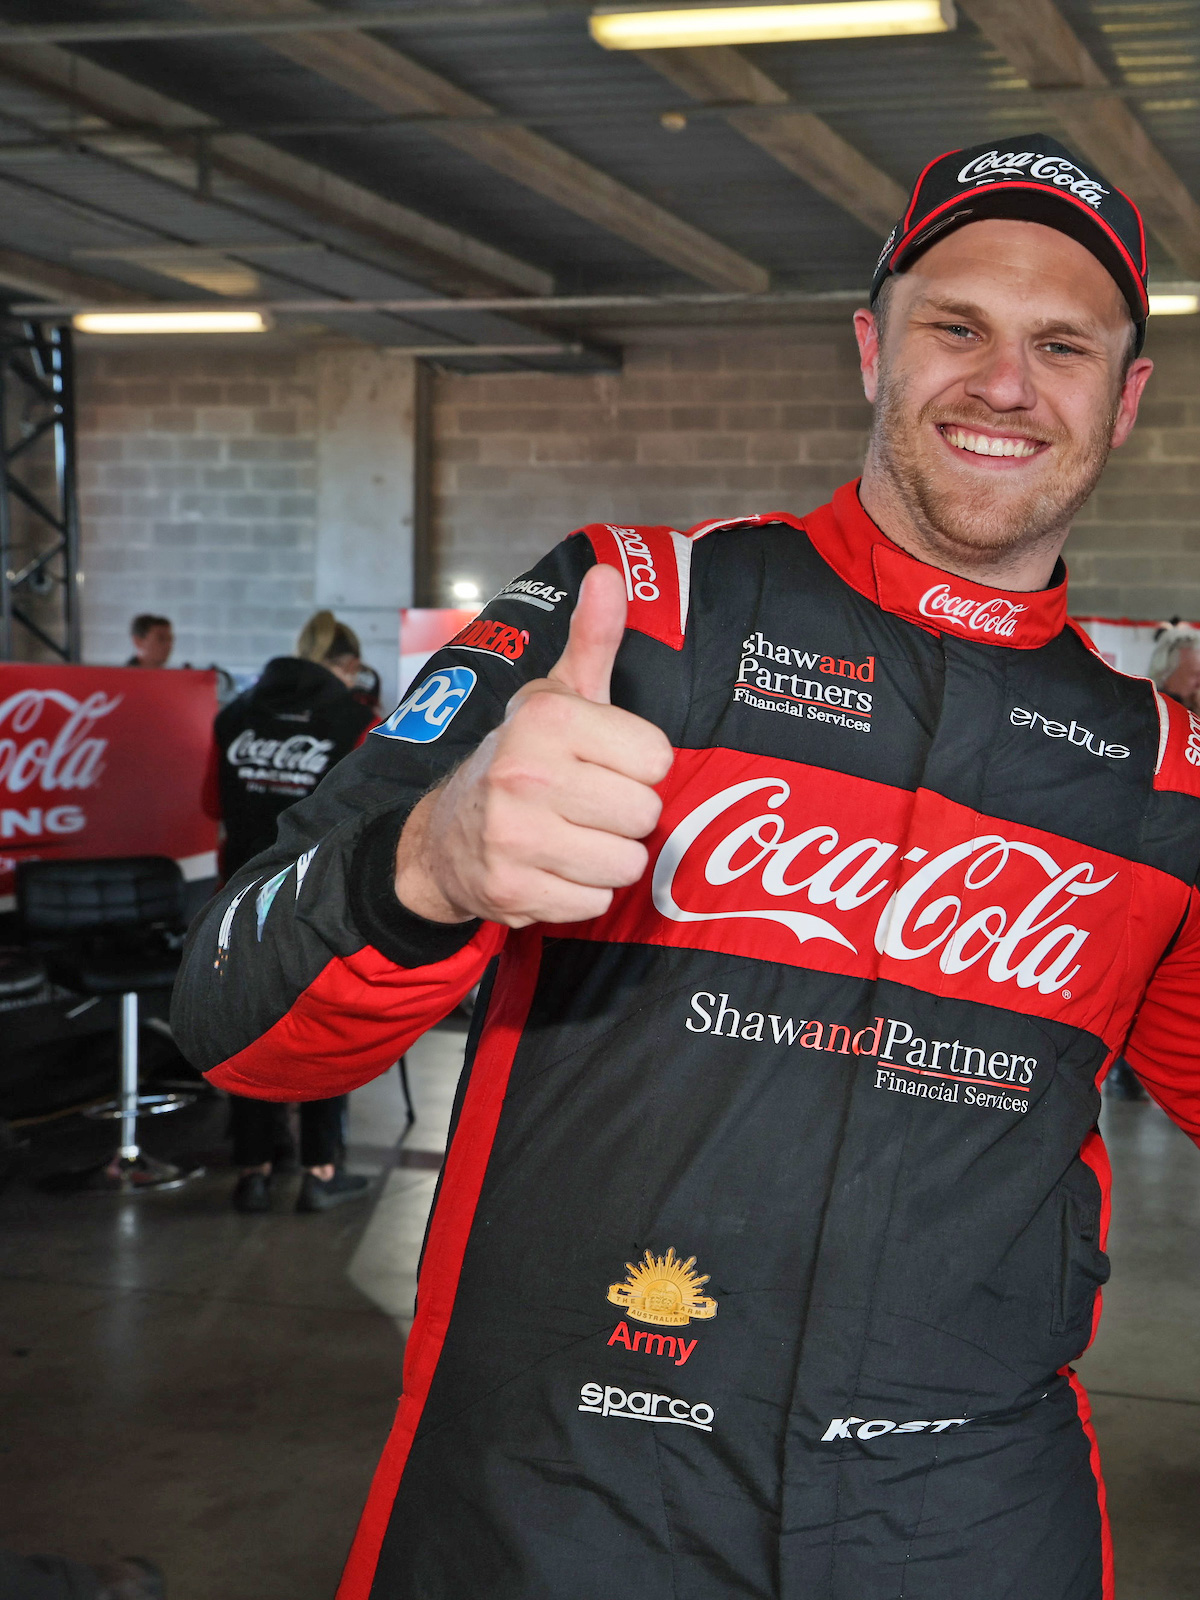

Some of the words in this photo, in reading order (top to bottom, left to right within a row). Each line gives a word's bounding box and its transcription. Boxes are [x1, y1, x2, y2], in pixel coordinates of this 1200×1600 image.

[957, 150, 1110, 209] Coca-Cola
[503, 580, 568, 602] PAGAS
[919, 584, 1029, 637] Coca-Cola
[735, 657, 873, 713] Partners
[732, 688, 803, 718] Financial
[806, 705, 871, 733] Services
[1010, 707, 1131, 760] erebus
[651, 776, 1119, 996] Coca-Cola
[874, 1069, 961, 1104] Financial
[963, 1086, 1029, 1115] Services
[616, 1296, 636, 1304] THE
[606, 1320, 698, 1367] Army
[578, 1382, 715, 1431] sparco
[820, 1416, 974, 1442] KOST
